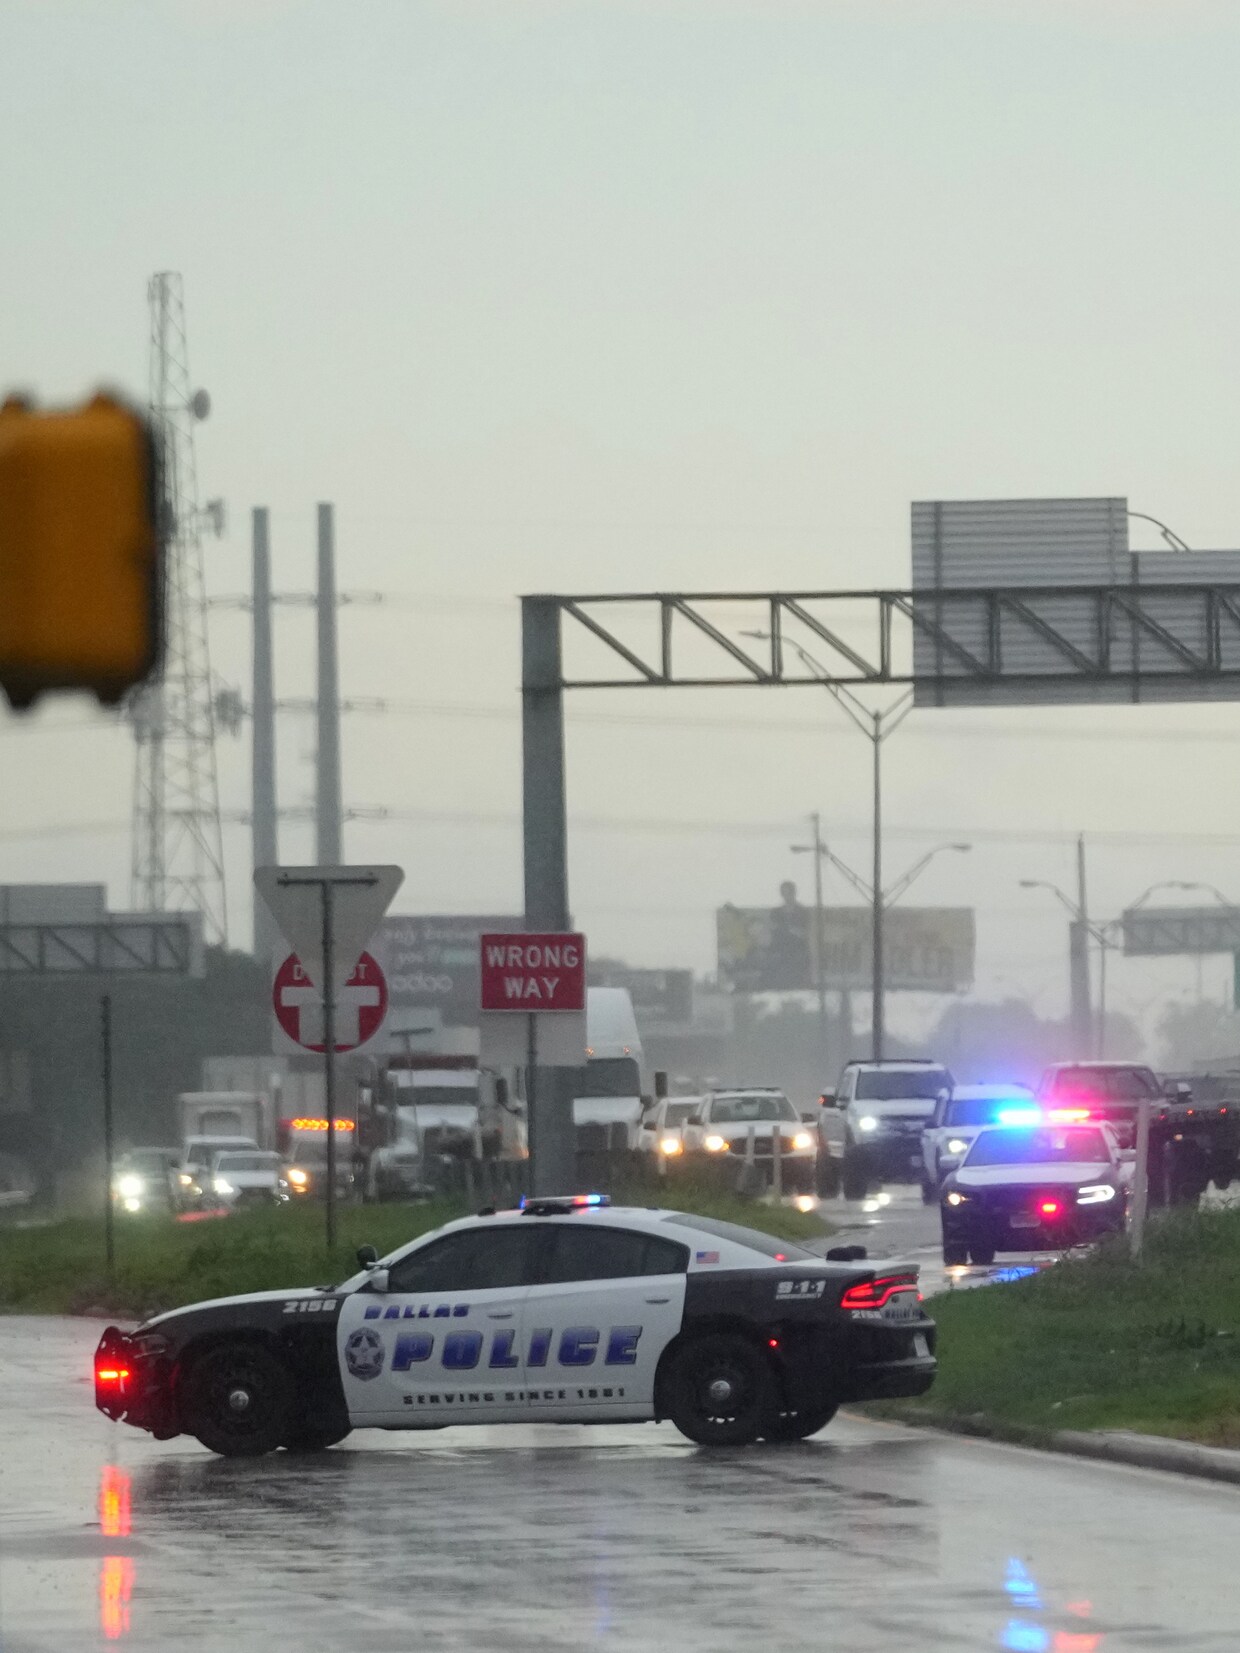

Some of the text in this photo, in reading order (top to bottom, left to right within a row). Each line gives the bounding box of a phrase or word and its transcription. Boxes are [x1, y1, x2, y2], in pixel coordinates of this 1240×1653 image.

[486, 945, 580, 968] WRONG
[503, 976, 561, 999] WAY
[364, 1304, 470, 1320] DALLAS
[390, 1325, 643, 1371] POLICE
[403, 1392, 495, 1405] SERVING
[505, 1389, 567, 1402] SINCE
